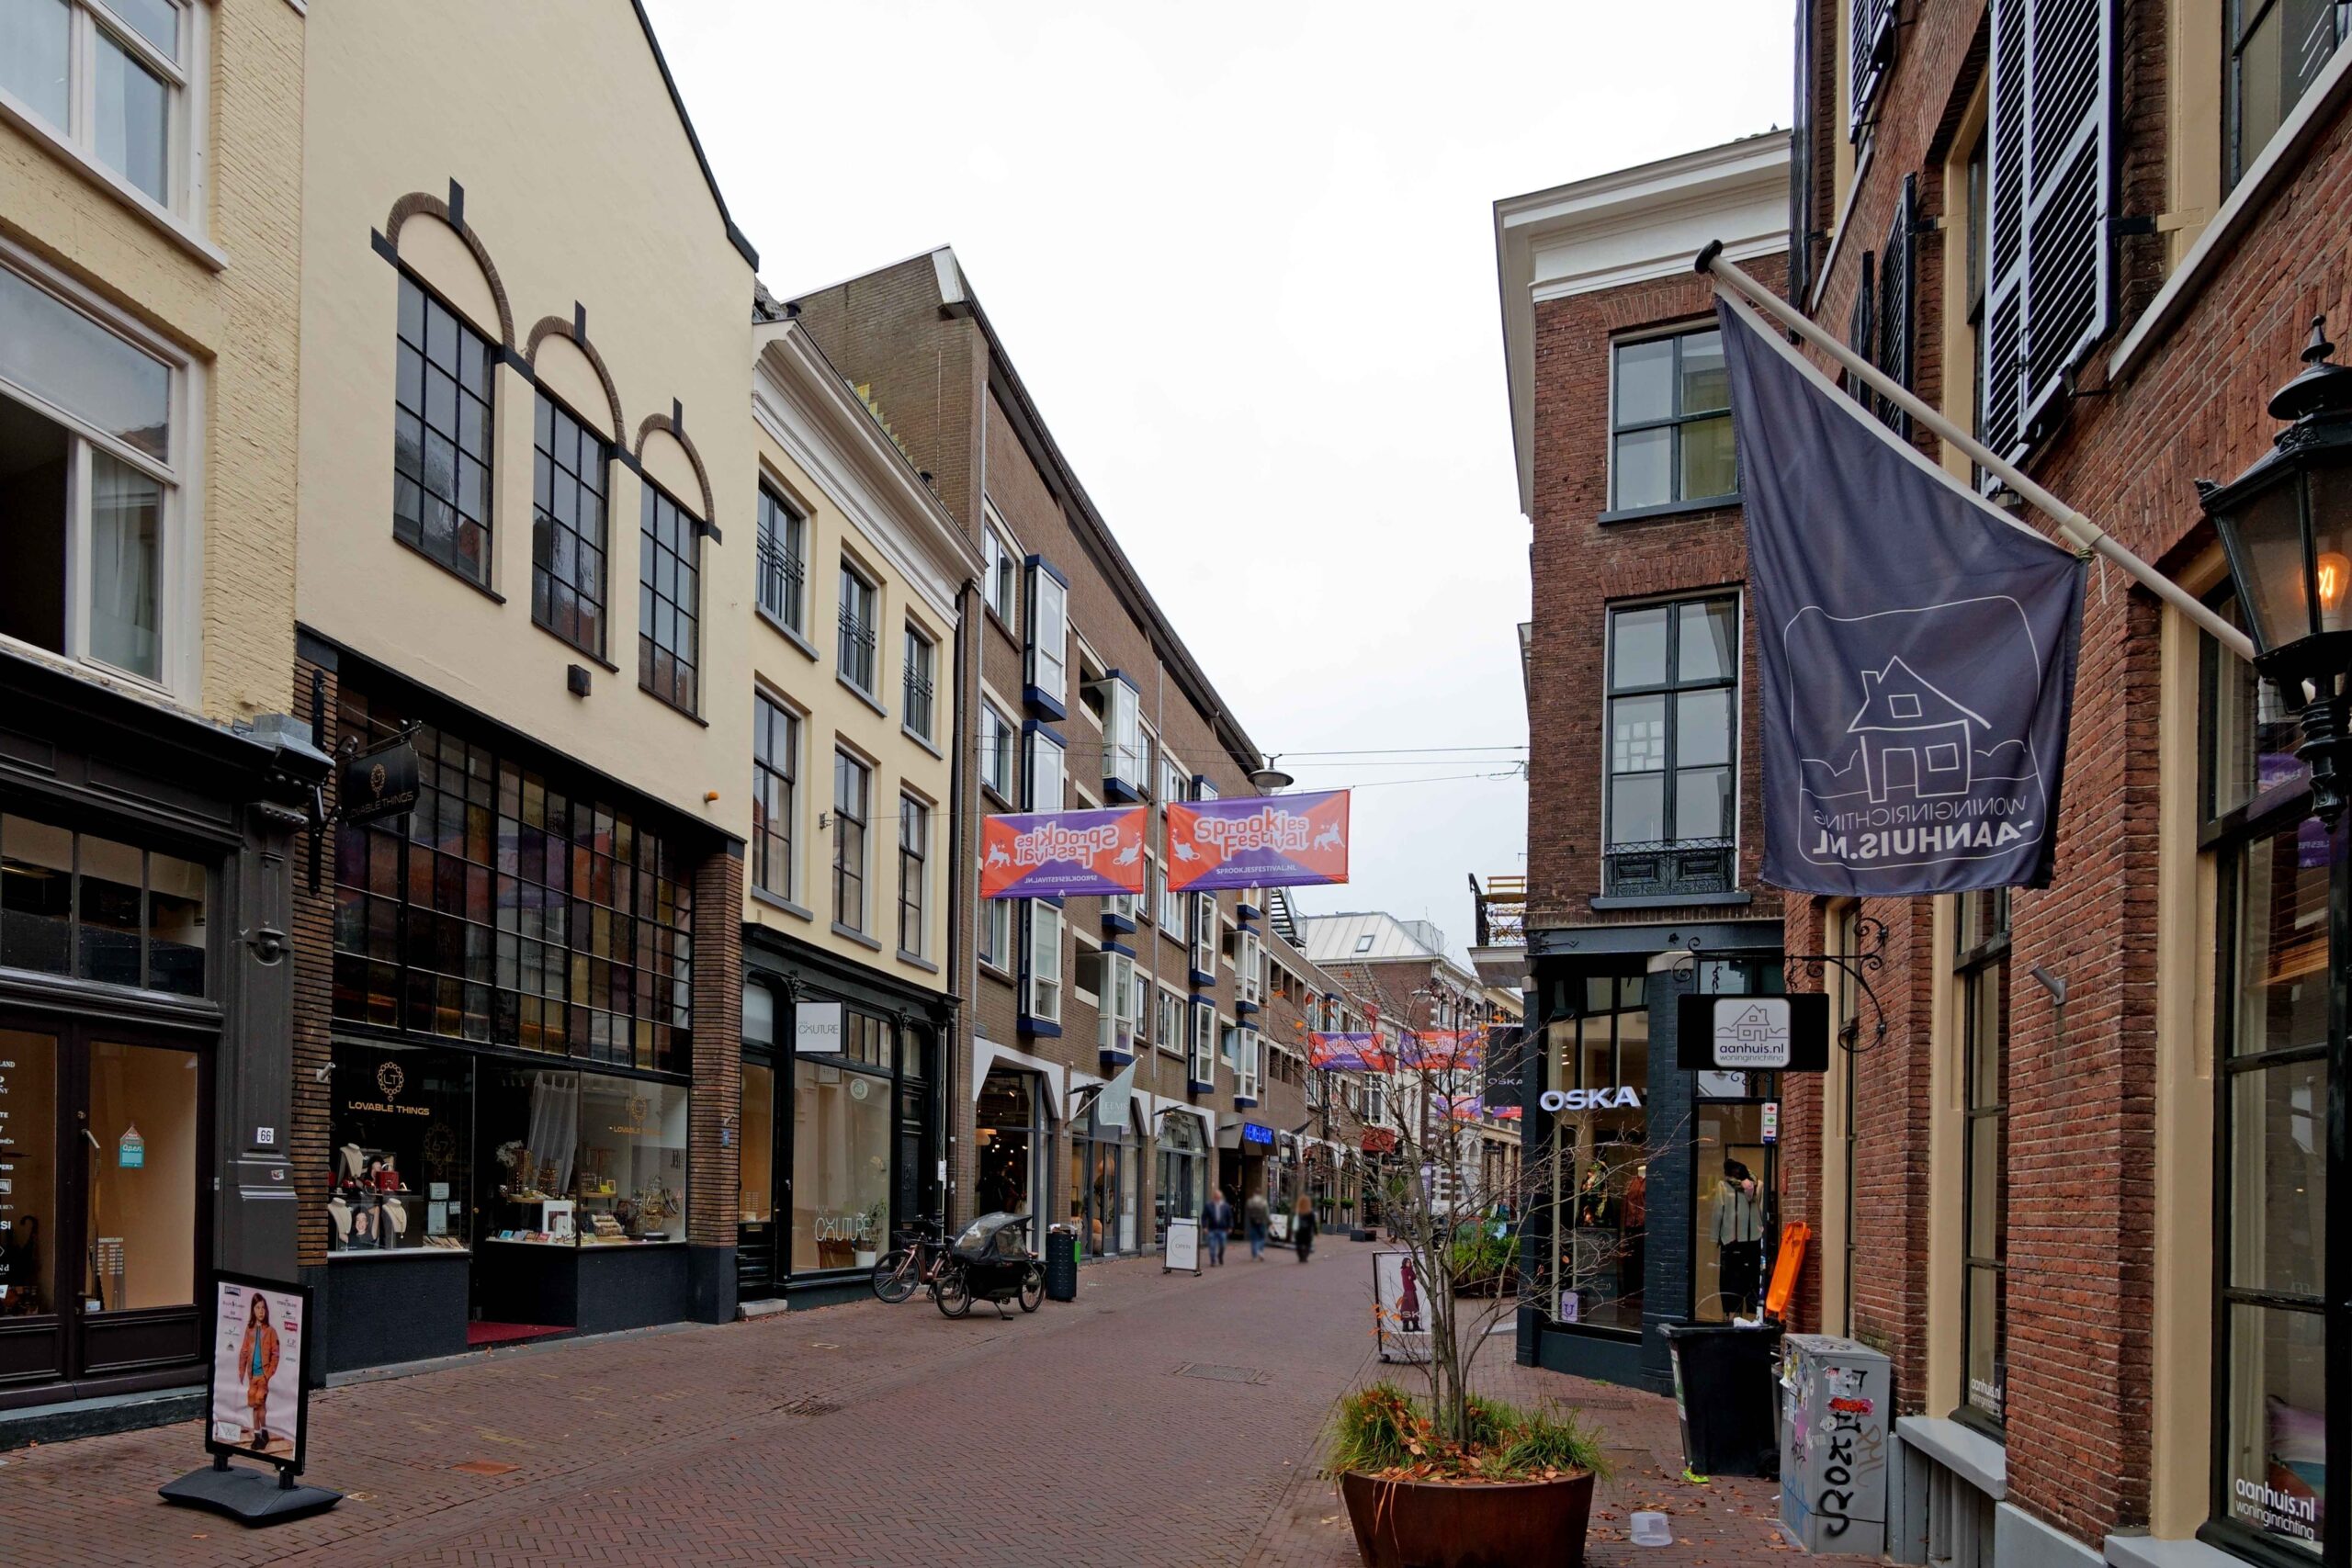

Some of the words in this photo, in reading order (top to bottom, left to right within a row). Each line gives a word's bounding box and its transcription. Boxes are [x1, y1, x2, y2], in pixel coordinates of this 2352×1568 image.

[382, 790, 413, 807] THINGS
[1196, 808, 1307, 841] Sprookjes
[1223, 829, 1305, 859] Festival
[1216, 864, 1297, 874] SPROOKJESFESTIVAL.NL
[1719, 1043, 1784, 1054] aanhuis.nl
[1719, 1055, 1784, 1064] woninginrichting
[349, 1100, 394, 1112] LOVABLE
[396, 1105, 430, 1115] THINGS
[1540, 1086, 1642, 1111] OSKA
[260, 1130, 272, 1142] 66
[1971, 1378, 2001, 1400] aanhuis.nl
[2235, 1478, 2314, 1521] aanhuis.nl
[2235, 1500, 2314, 1542] woninginrichting
